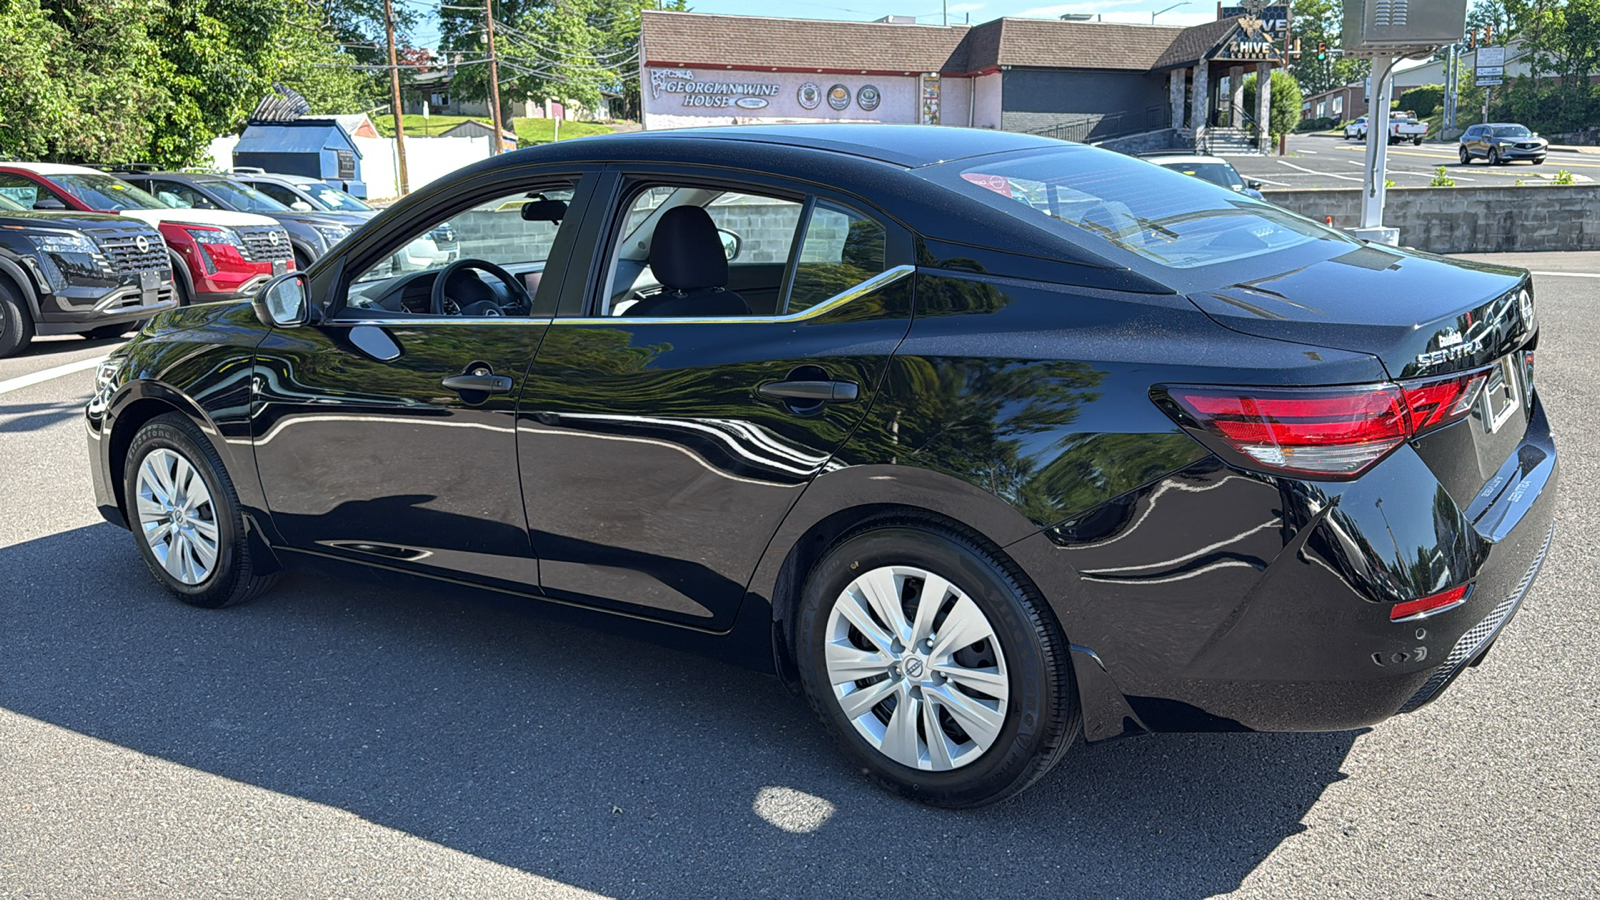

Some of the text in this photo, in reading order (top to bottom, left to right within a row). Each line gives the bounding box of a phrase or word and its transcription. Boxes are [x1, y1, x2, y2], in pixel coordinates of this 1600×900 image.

[1262, 19, 1288, 31] VE
[1240, 41, 1270, 54] HIVE
[666, 81, 780, 96] GEORGIAN WINE
[682, 95, 730, 107] HOUSE
[1417, 340, 1483, 367] SENTRA
